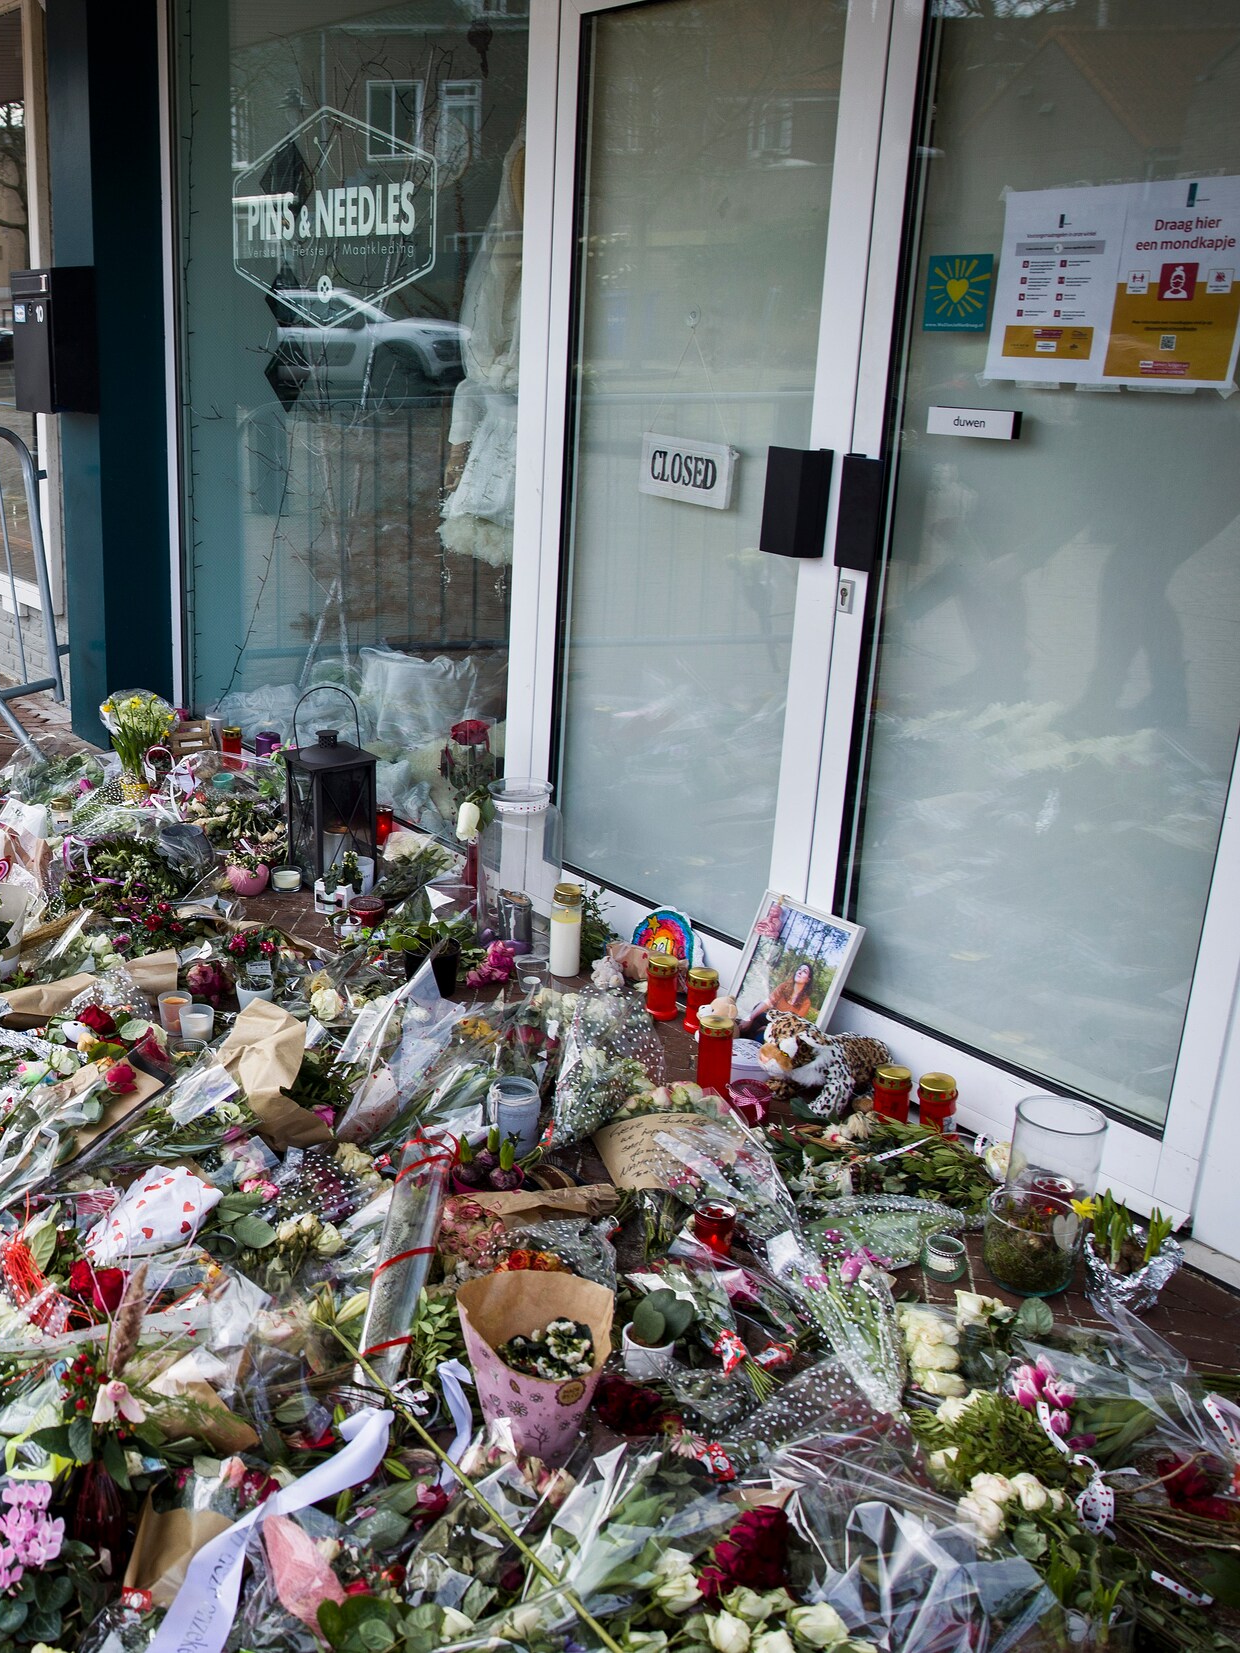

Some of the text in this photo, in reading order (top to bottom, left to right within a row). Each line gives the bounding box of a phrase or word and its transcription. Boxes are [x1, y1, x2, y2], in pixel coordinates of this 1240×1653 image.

[247, 180, 416, 241] PINS & NEEDLES
[1154, 216, 1223, 233] Draag hier
[342, 241, 415, 258] Maatkleding
[1135, 235, 1237, 252] een mondkapje
[36, 305, 44, 323] 10
[953, 415, 986, 429] duwen
[650, 449, 717, 490] CLOSED
